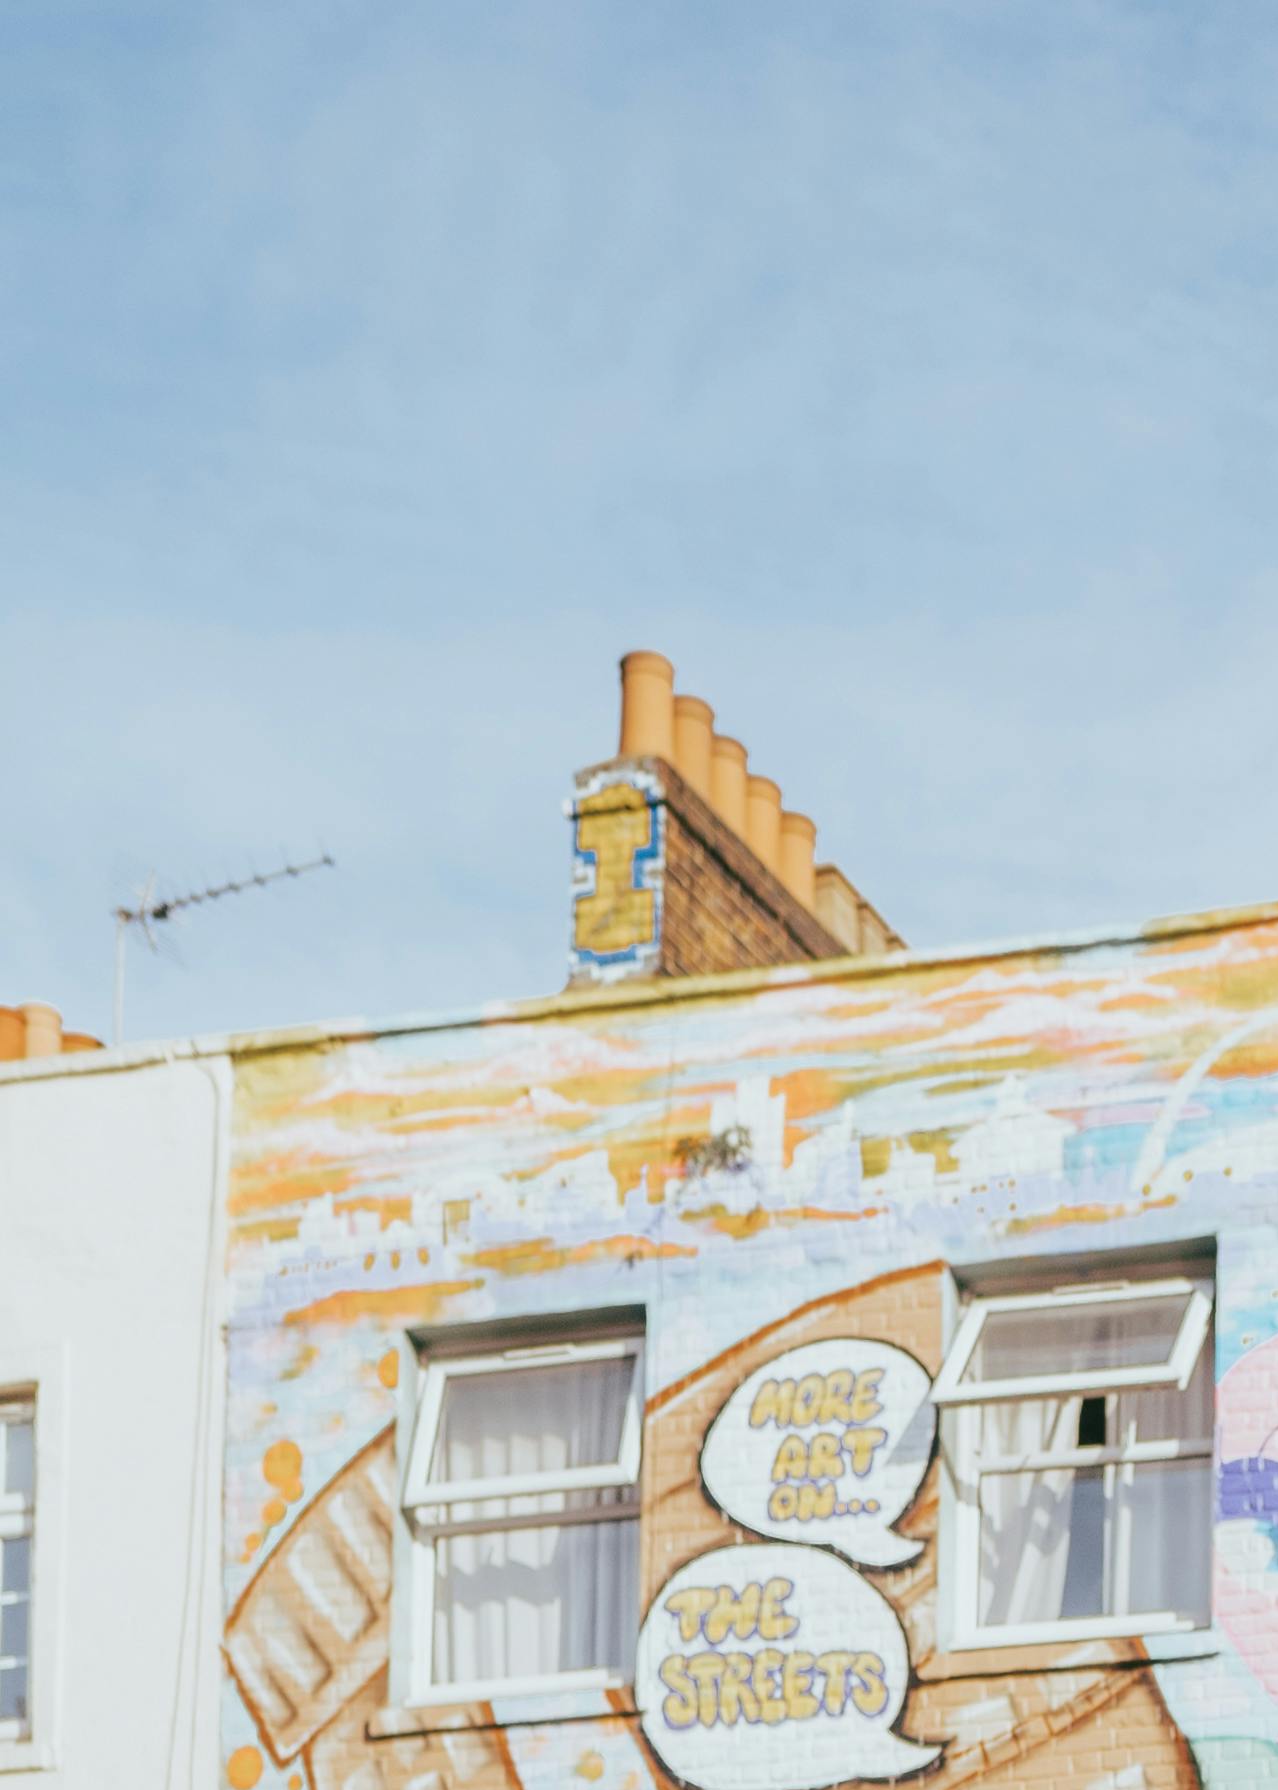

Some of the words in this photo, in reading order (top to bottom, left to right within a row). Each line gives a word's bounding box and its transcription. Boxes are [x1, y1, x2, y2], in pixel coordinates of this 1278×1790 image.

[748, 1367, 887, 1430] MORE
[771, 1427, 887, 1484] ART
[662, 1576, 800, 1644] THE
[659, 1648, 889, 1731] STREETS
